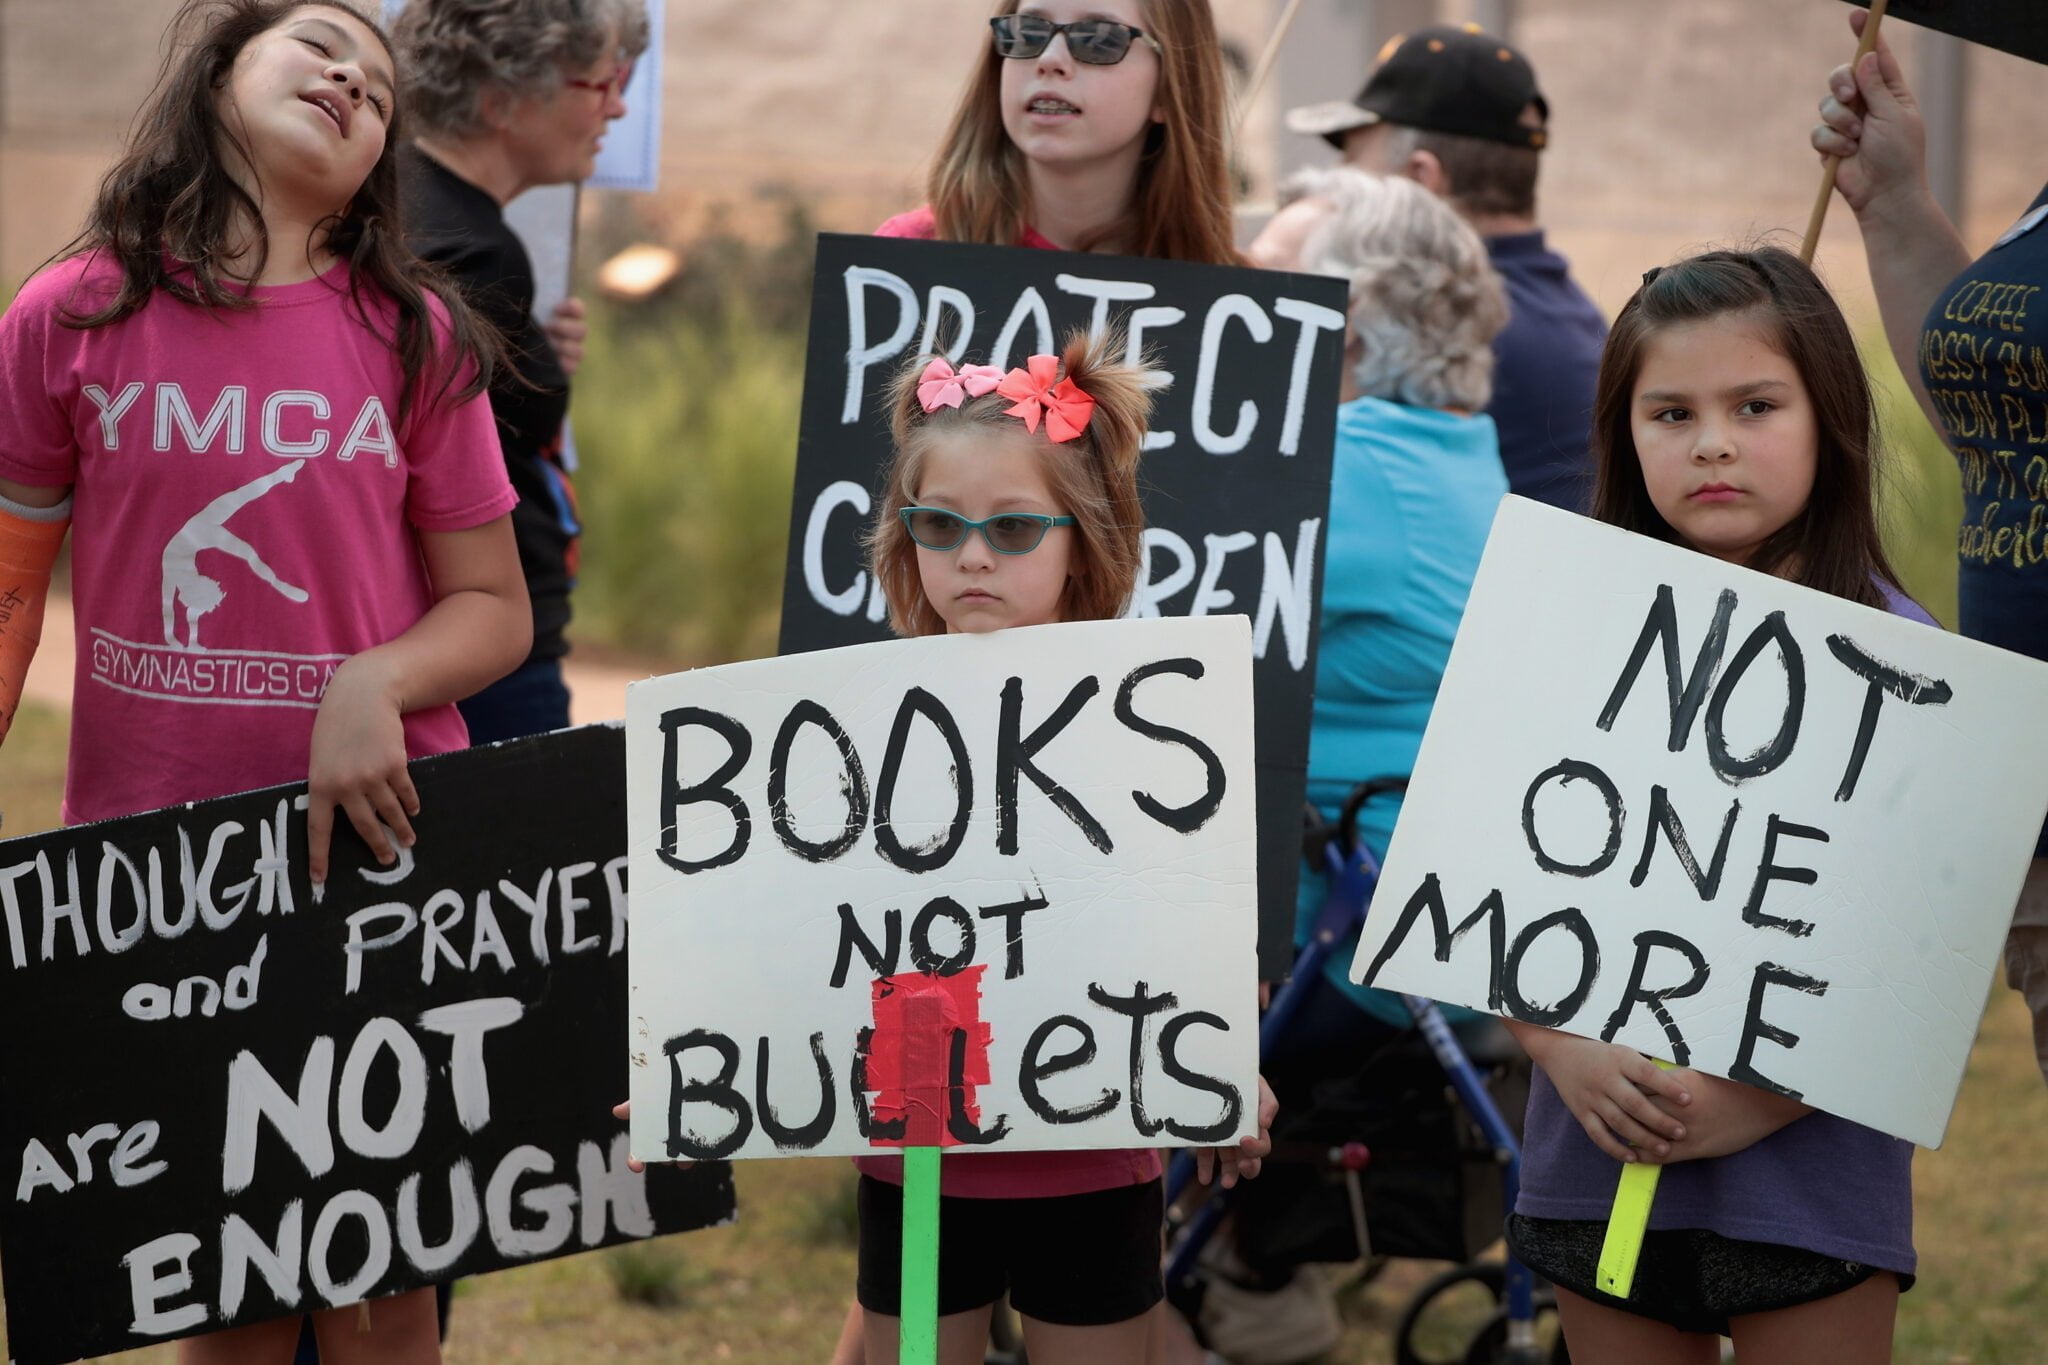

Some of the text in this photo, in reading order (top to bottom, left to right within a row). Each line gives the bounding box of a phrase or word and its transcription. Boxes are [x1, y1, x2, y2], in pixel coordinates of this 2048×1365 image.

[1944, 280, 2040, 332] COFFEE
[83, 382, 399, 468] YMCA
[2001, 393, 2048, 443] PL
[93, 638, 339, 698] GYMNASTICS CA
[1596, 584, 1953, 803] NOT
[656, 657, 1226, 874] BOOKS
[0, 796, 415, 969] THOUGHS
[1522, 758, 1830, 938] ONE
[122, 932, 268, 1021] and
[829, 870, 1050, 989] NOT
[1363, 872, 1829, 1100] MORE
[16, 1120, 168, 1202] Are
[222, 997, 525, 1196] NOT
[120, 1131, 656, 1337] ENOUGH
